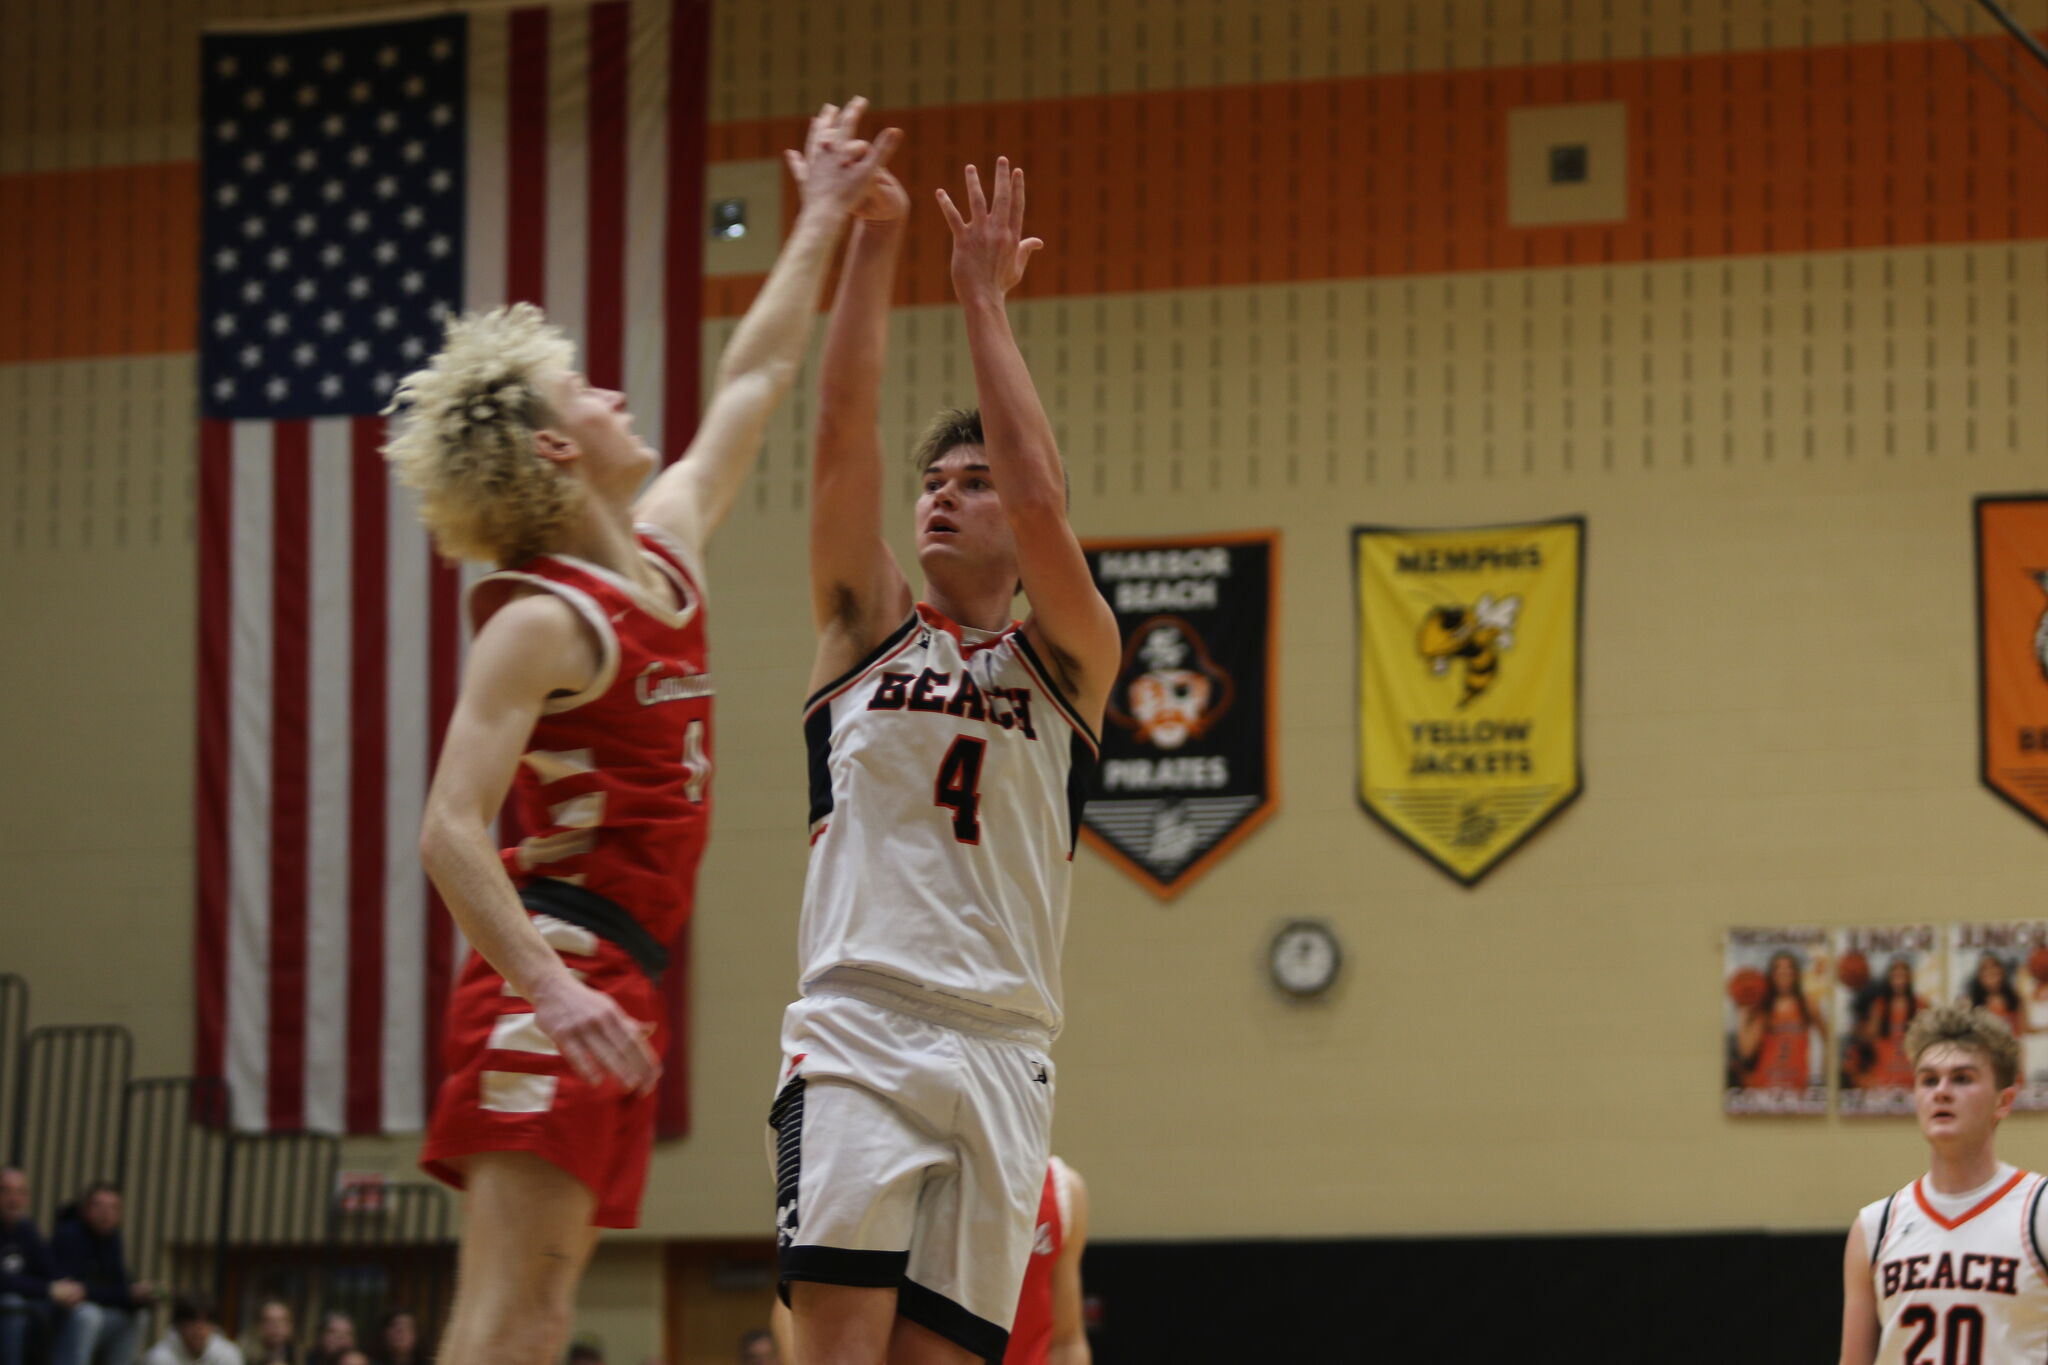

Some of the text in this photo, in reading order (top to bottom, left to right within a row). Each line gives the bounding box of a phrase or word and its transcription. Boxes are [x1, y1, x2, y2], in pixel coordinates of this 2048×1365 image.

[1099, 548, 1231, 580] HARBOR
[1396, 544, 1542, 573] MEMPHIS
[1116, 579, 1218, 610] BEACH
[867, 667, 1038, 741] BEACH
[1410, 718, 1534, 745] YELLOW
[1103, 755, 1229, 791] PIRATES
[1409, 749, 1534, 776] JACKETS
[934, 733, 987, 846] 4
[1882, 1251, 2020, 1300] BEACH
[1899, 1303, 1985, 1365] 20
